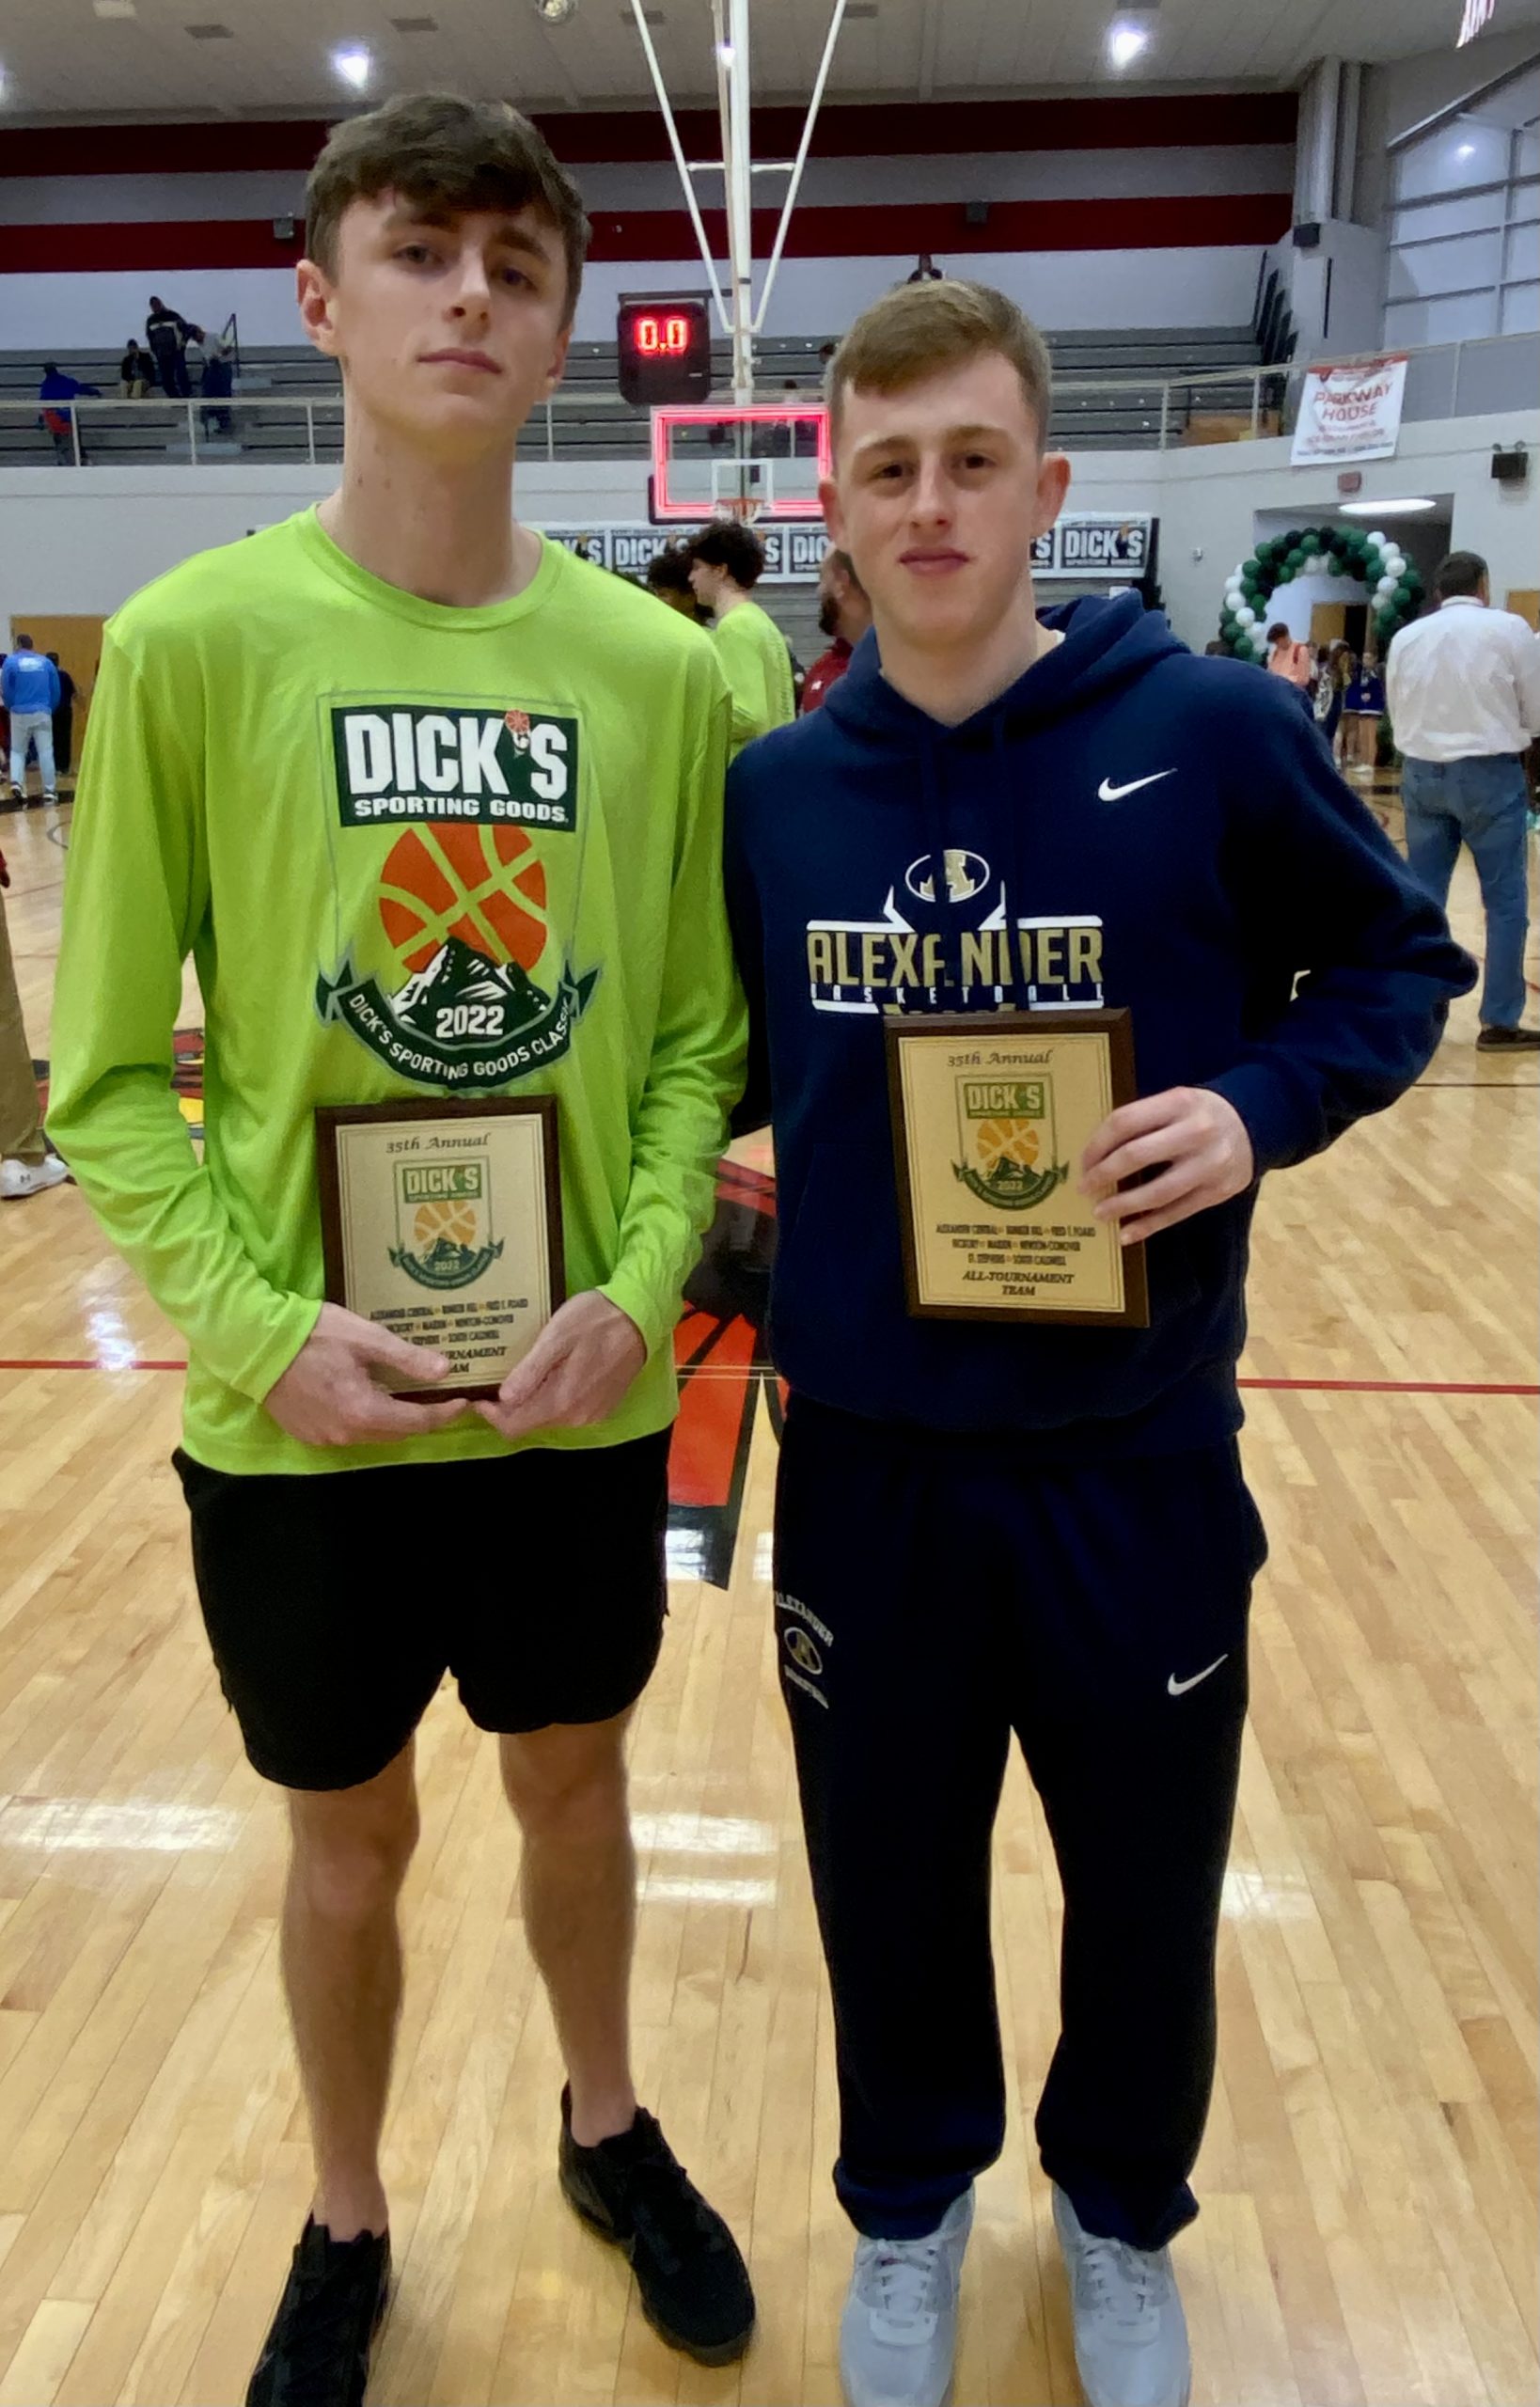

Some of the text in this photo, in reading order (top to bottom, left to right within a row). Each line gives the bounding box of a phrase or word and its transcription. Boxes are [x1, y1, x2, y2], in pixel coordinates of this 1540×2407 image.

[1313, 383, 1392, 405] PARKWAY
[1322, 402, 1376, 421] HOUSE
[1064, 529, 1143, 558] DICK'S
[344, 711, 568, 801] DICK'S
[354, 796, 566, 823] SPORTING GOODS
[436, 1004, 505, 1038] 2022
[350, 994, 393, 1044] DICK'S
[389, 1043, 468, 1080] SPORTING
[473, 1046, 531, 1076] GOODS
[947, 1048, 1054, 1067] 35th Annual
[966, 1084, 1041, 1110] DICK'S
[386, 1132, 491, 1153] 35th Annual
[406, 1167, 479, 1194] DICK'S
[962, 1270, 1075, 1283] ALL-TOURNAMENT
[1001, 1284, 1035, 1296] TEAM
